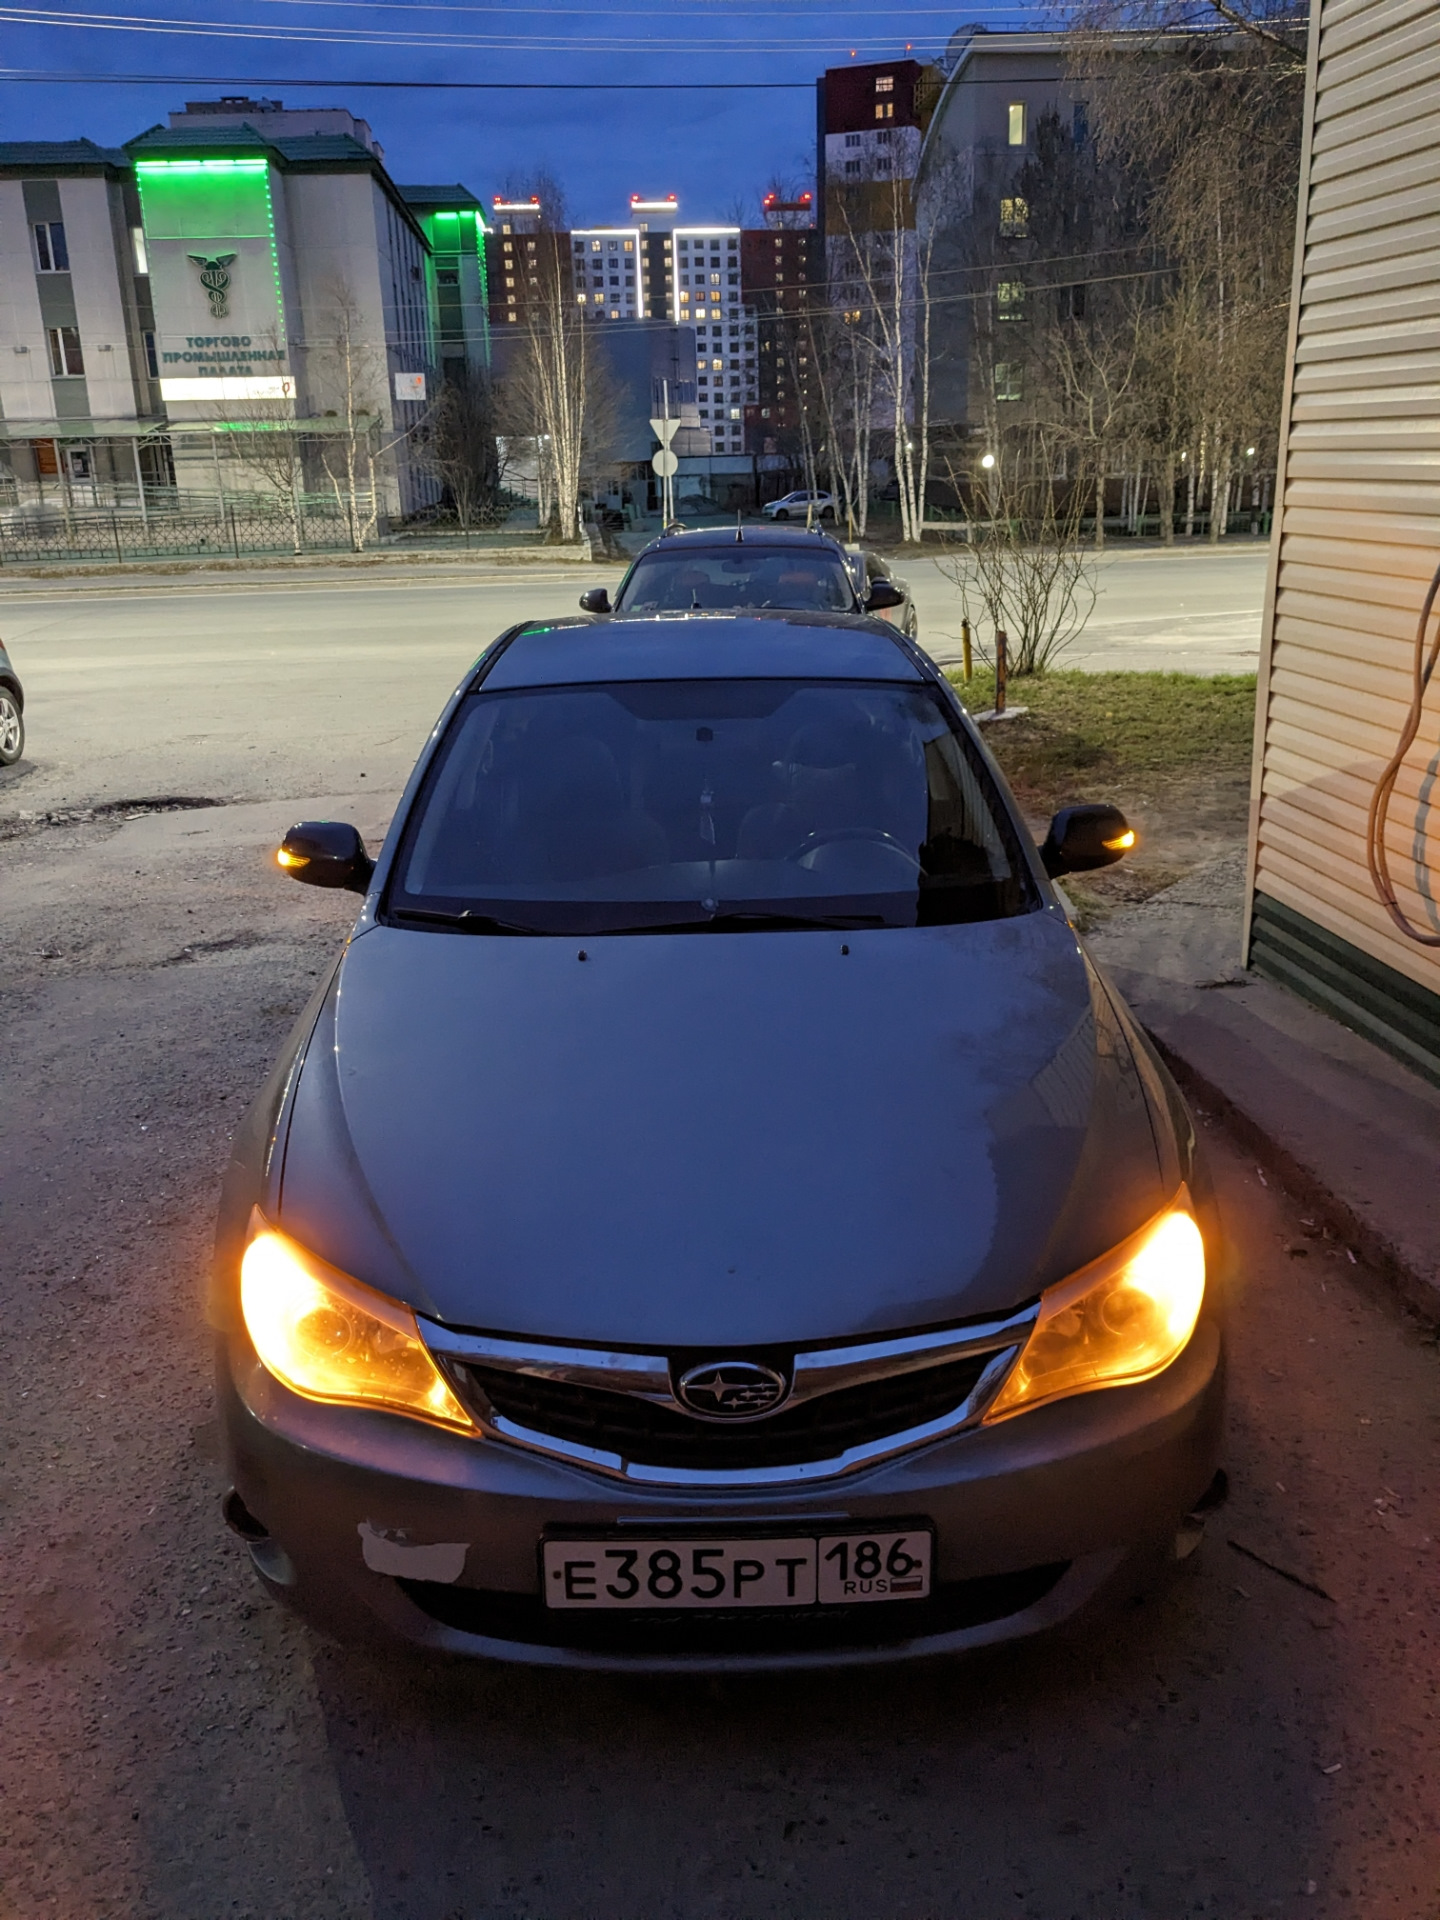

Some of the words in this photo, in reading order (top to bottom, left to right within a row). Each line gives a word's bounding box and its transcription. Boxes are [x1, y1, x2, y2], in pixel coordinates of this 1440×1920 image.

[186, 336, 251, 348] ТОРГОВО
[162, 350, 285, 363] ПРОМЫШЛЕННАЯ
[198, 366, 253, 376] ПАЛАТА
[825, 1538, 914, 1581] 186
[844, 1579, 888, 1595] RUS
